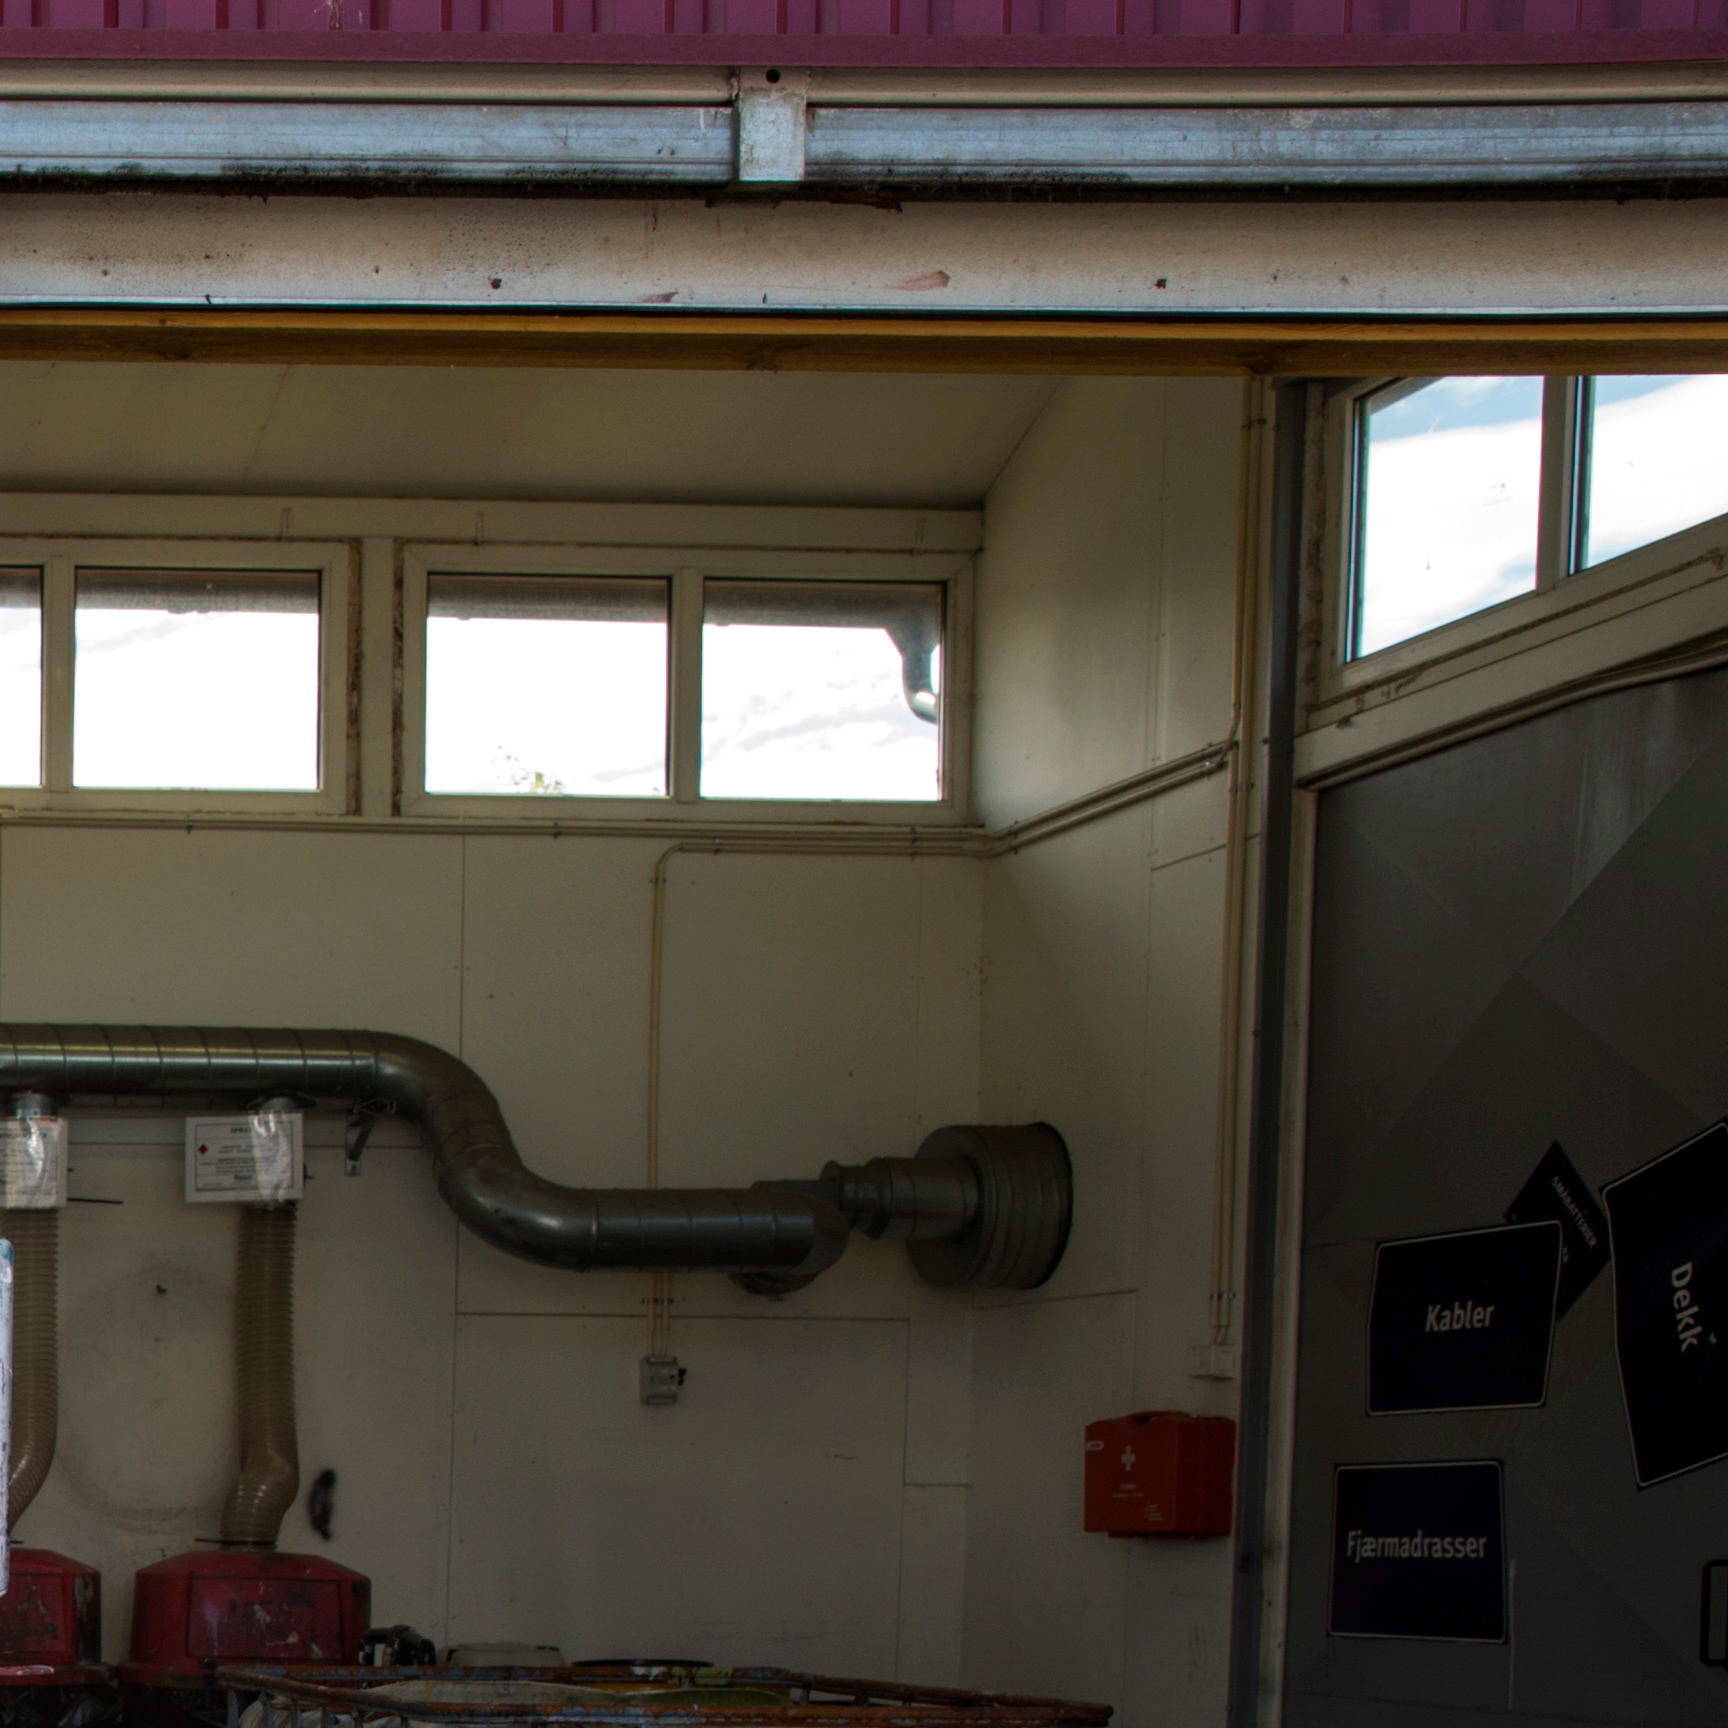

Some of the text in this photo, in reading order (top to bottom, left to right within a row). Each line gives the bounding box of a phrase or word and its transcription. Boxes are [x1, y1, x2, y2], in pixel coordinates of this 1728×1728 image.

[1425, 1302, 1495, 1332] Kabler
[1671, 1261, 1704, 1353] Dekk
[1345, 1530, 1487, 1563] Fjærmadrasser
